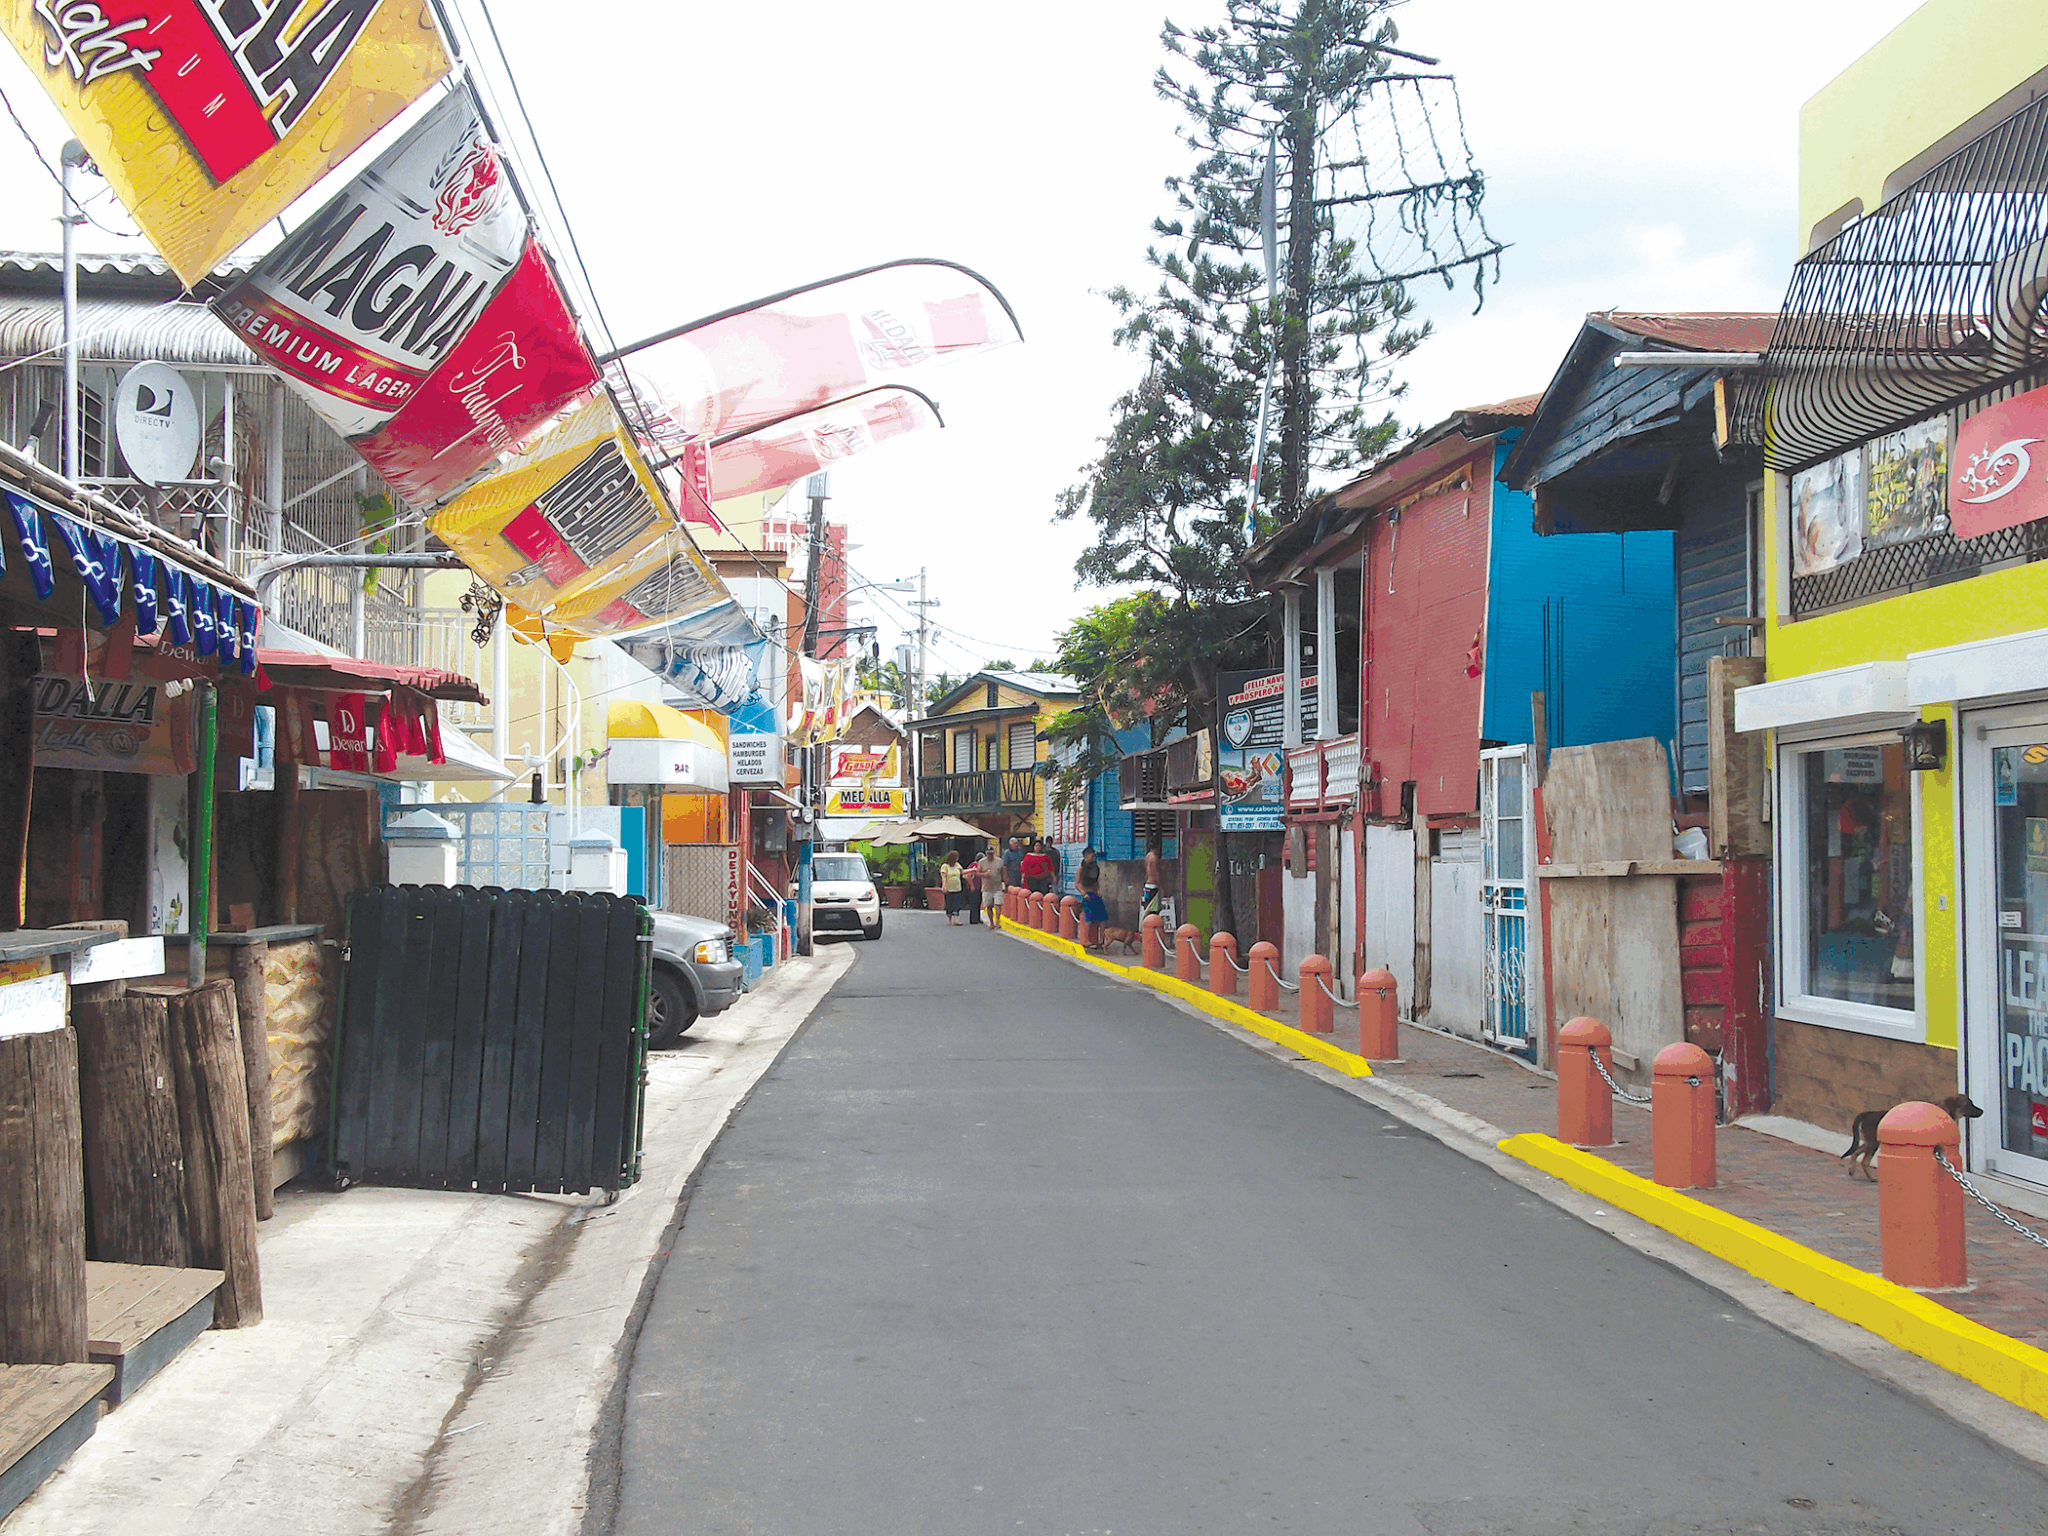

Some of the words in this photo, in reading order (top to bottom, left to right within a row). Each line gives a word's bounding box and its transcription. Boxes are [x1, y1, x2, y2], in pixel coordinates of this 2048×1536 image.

[264, 193, 489, 360] MAGNA
[225, 301, 343, 376] PREMIUM
[344, 365, 410, 400] LAGER
[134, 414, 170, 429] DIRECTV
[534, 436, 662, 570] MEDALLA
[33, 679, 158, 723] DALLA
[1229, 696, 1234, 704] Y
[1235, 688, 1273, 702] PROSPERO
[731, 741, 767, 749] SANDWICHES
[732, 750, 766, 758] HAMBURGER
[674, 763, 690, 774] BAR
[737, 759, 763, 767] HELADOS
[735, 768, 764, 776] CERVEZAS
[841, 790, 891, 803] MEDLLA
